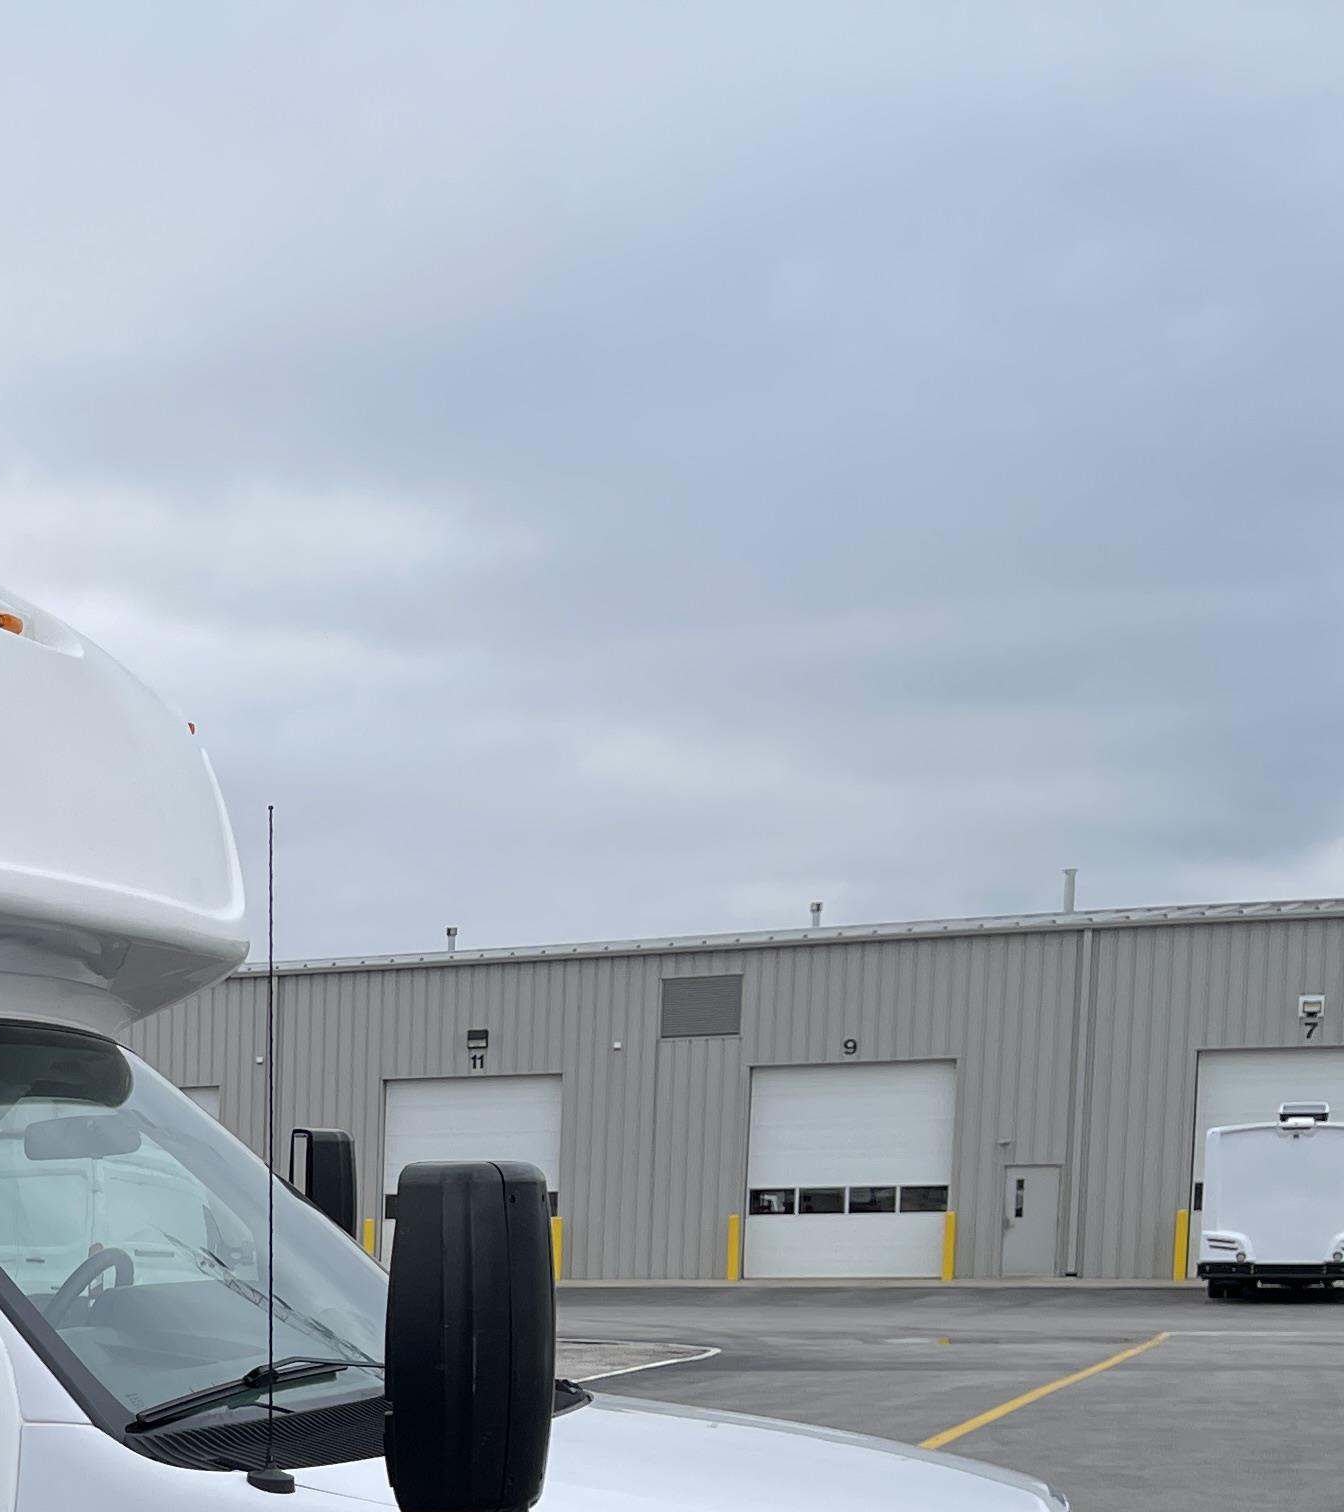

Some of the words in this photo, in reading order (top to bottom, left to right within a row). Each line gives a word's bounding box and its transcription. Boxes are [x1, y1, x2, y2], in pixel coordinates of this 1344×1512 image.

[1303, 1022, 1319, 1040] 7
[842, 1039, 858, 1056] 9
[470, 1054, 485, 1070] 11
